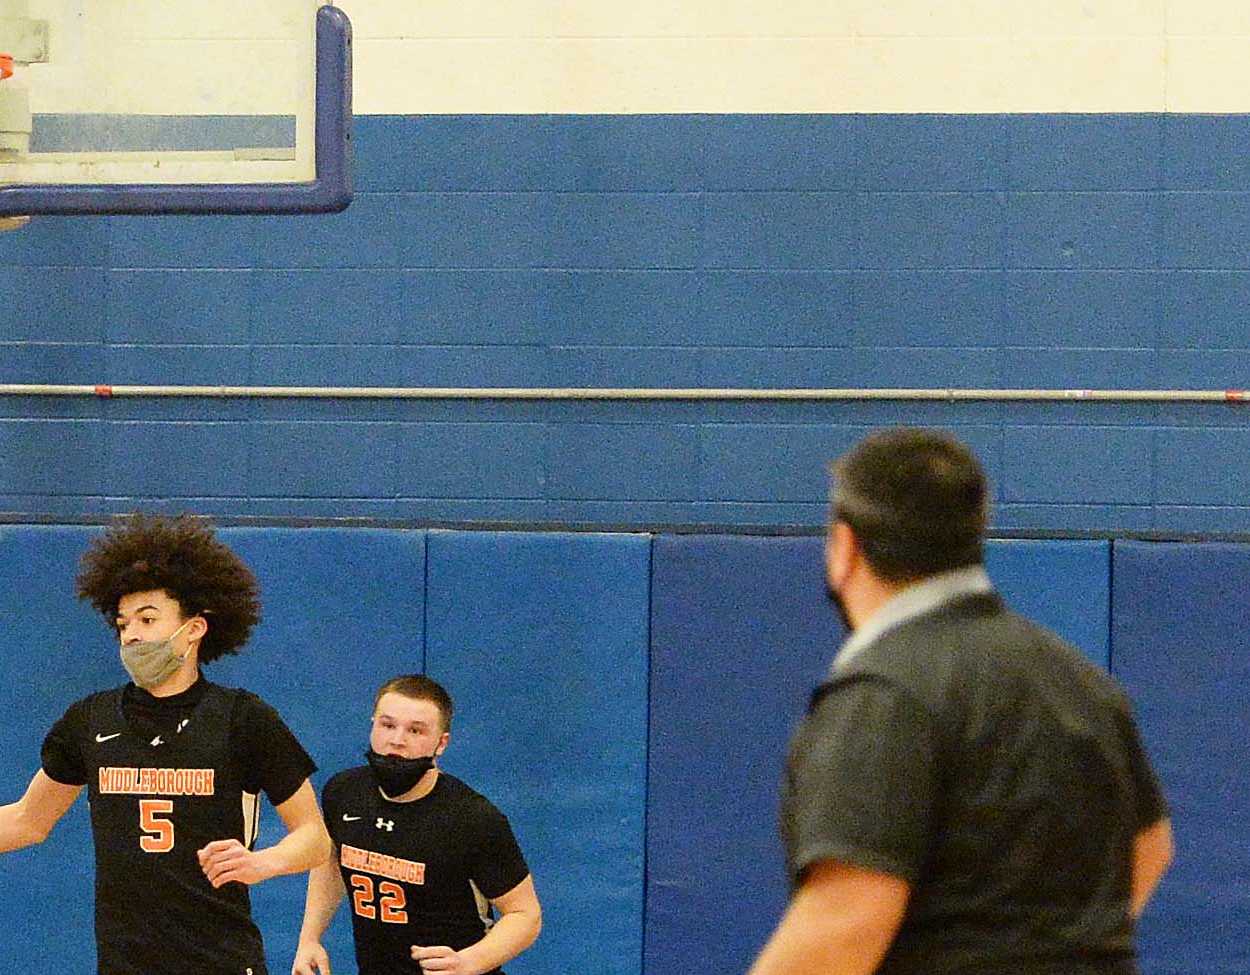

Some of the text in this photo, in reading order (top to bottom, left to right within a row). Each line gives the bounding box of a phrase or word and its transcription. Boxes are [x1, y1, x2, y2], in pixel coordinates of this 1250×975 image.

[98, 767, 215, 796] MIDDLEBOROUGH
[139, 799, 175, 853] 5
[350, 874, 409, 924] 22
